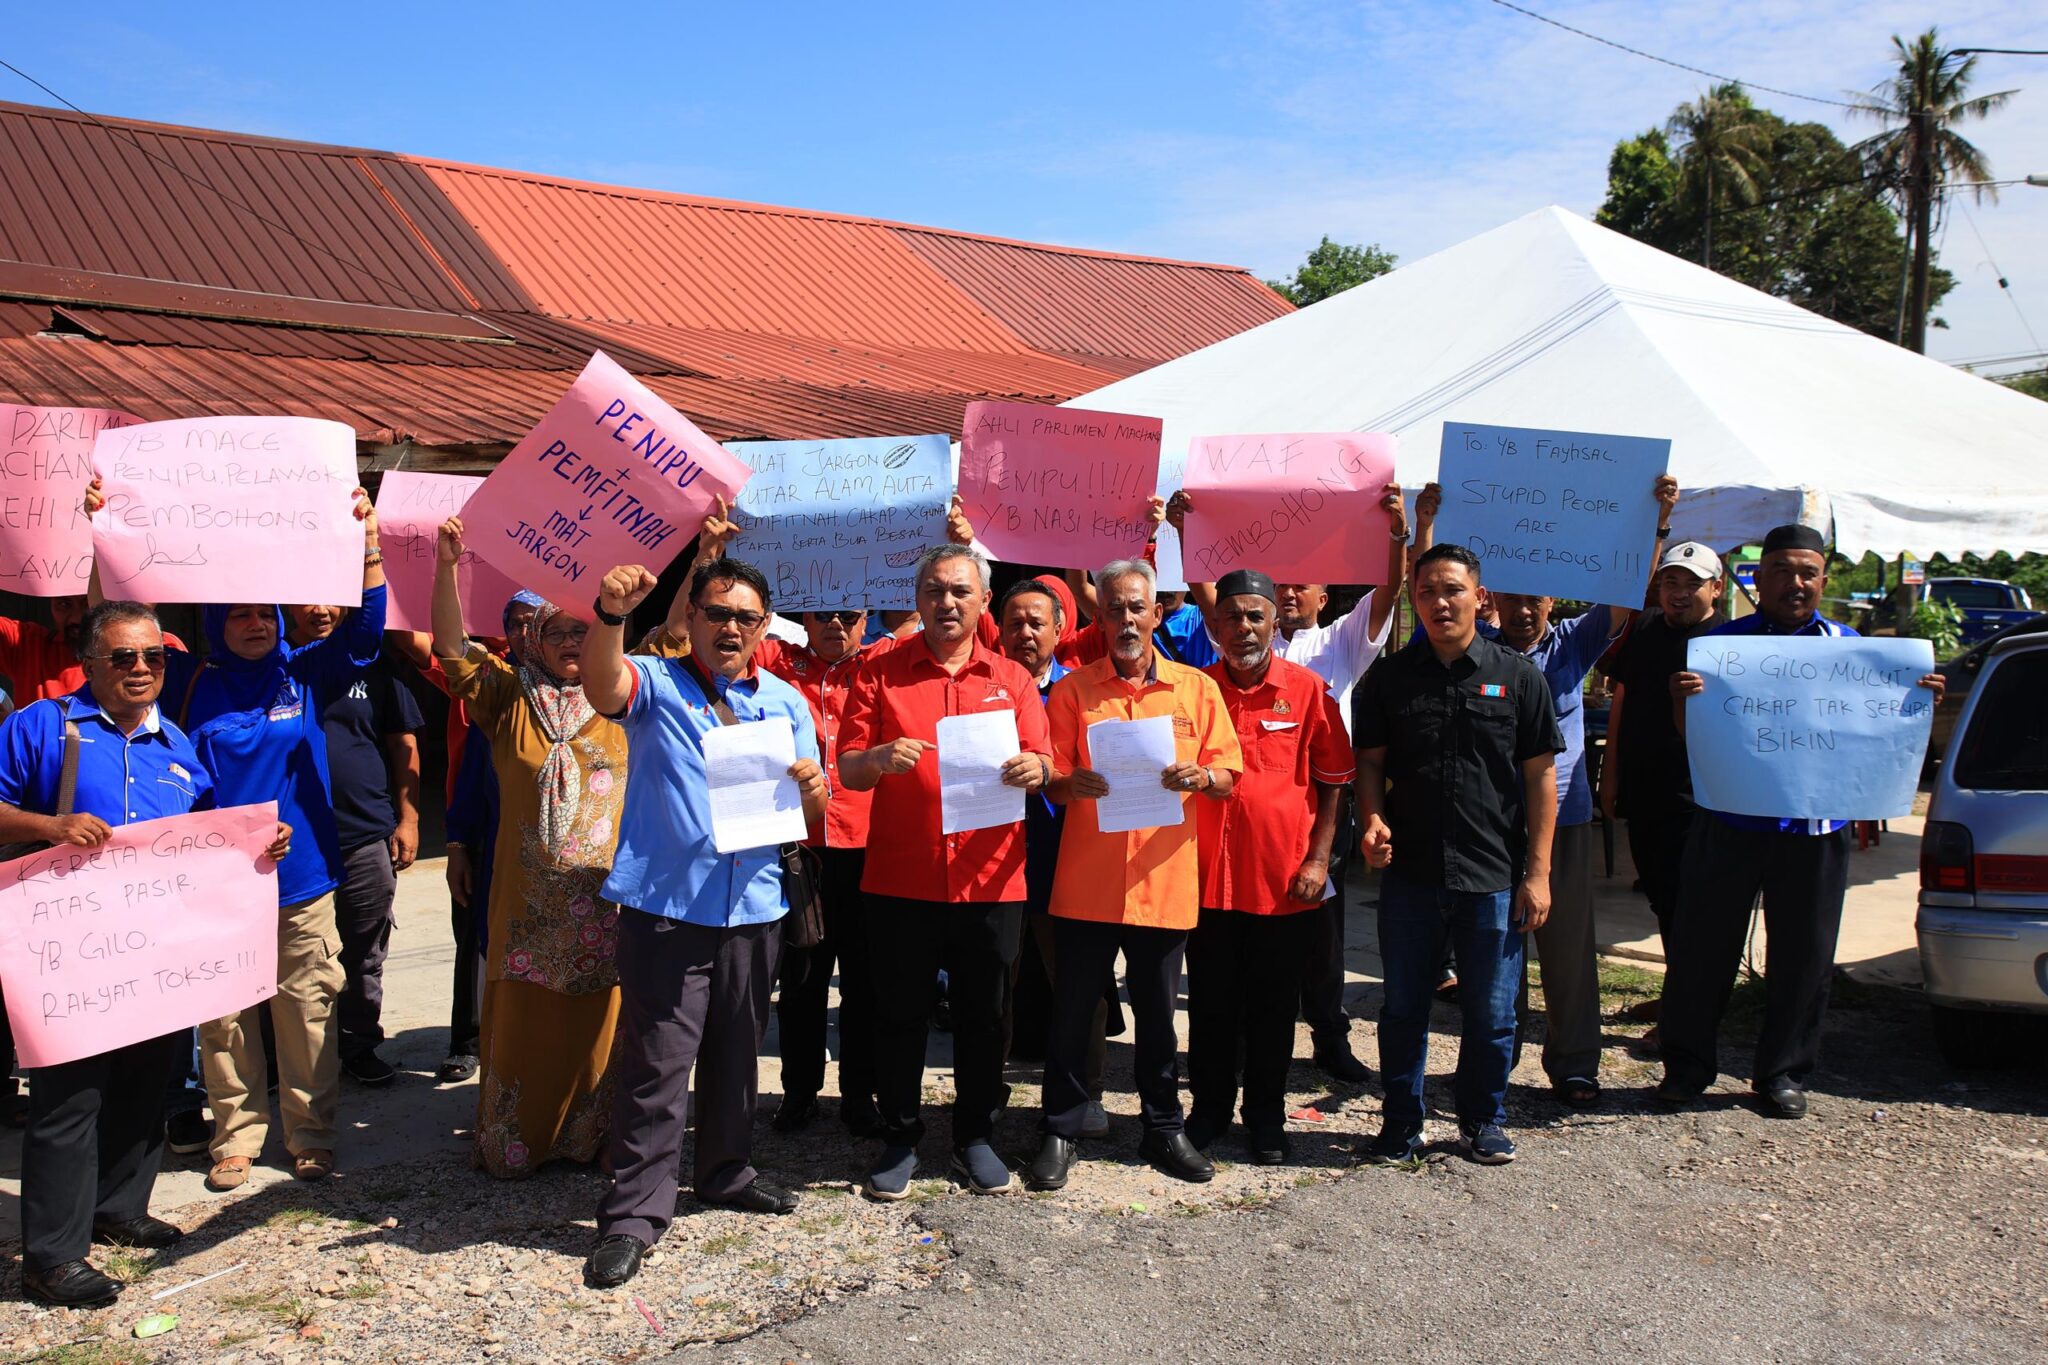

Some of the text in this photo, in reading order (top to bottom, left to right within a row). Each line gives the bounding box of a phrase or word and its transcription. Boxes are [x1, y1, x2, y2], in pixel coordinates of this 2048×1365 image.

[975, 413, 1019, 435] AHLI
[1032, 418, 1109, 438] PARLIMEN
[119, 429, 280, 460] YB MACE
[595, 398, 704, 488] PENIPU
[1497, 436, 1518, 457] YB
[802, 448, 878, 476] JARGON
[402, 480, 476, 511] MAT
[538, 440, 677, 550] PEMFITNAH
[883, 475, 935, 496] AUTA
[107, 494, 318, 531] PEMBOHONG
[847, 506, 897, 528] CAKAP
[1034, 508, 1081, 533] NASI
[1194, 448, 1371, 578] PEMBOHONG
[1514, 518, 1558, 533] ARE
[543, 510, 591, 548] MAT
[736, 536, 782, 553] FAKTA
[875, 526, 934, 544] BESAR
[506, 521, 587, 582] JARGON
[1469, 536, 1602, 573] DANGEROUS
[1706, 650, 1746, 678] YB
[1760, 654, 1818, 680] GILO
[1723, 695, 1931, 719] CAKAP TAK SERUPA
[17, 845, 137, 895] KERETA
[32, 891, 102, 925] ATAS
[28, 940, 62, 976] YB
[42, 979, 140, 1026] RAKYAT
[154, 960, 229, 993] TOKSE
